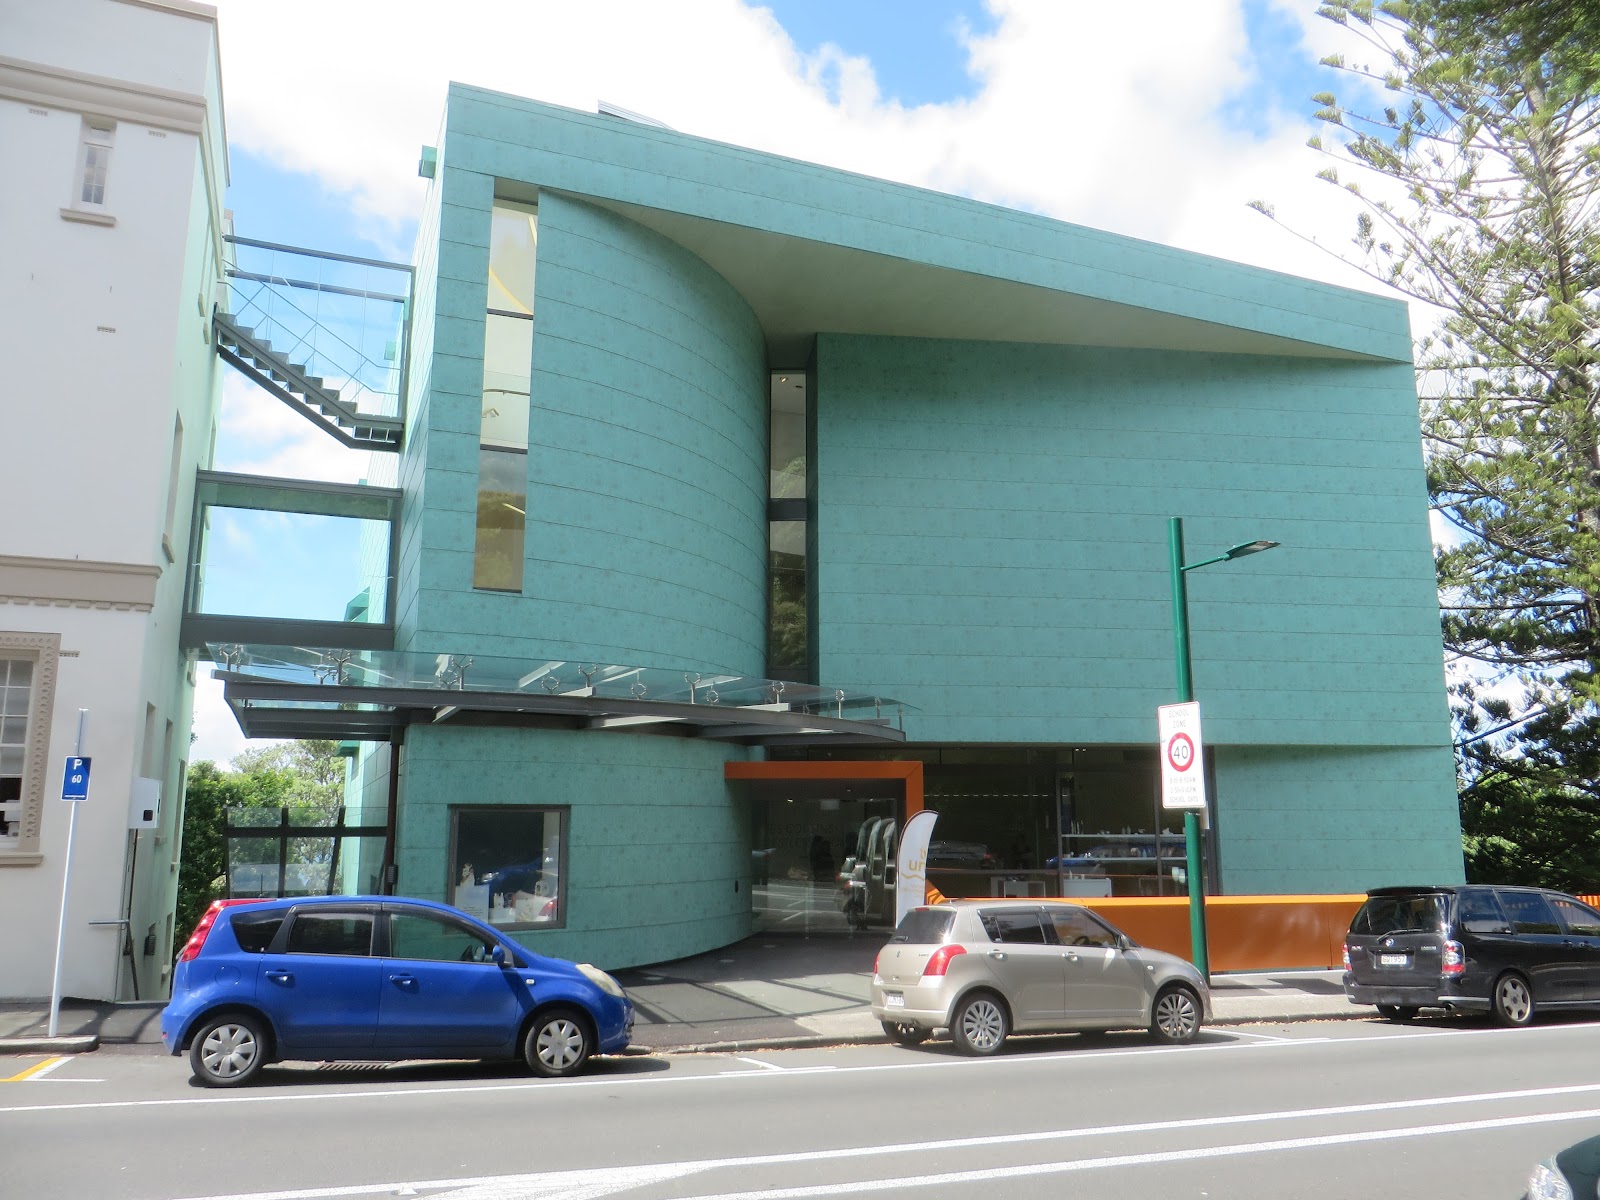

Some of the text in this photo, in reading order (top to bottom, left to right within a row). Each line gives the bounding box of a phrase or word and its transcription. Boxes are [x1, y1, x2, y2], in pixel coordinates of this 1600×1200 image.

[1169, 709, 1190, 718] SCHOOL
[1173, 720, 1187, 728] ZONE
[1173, 745, 1189, 759] 40
[73, 759, 83, 770] P
[71, 774, 82, 783] 60
